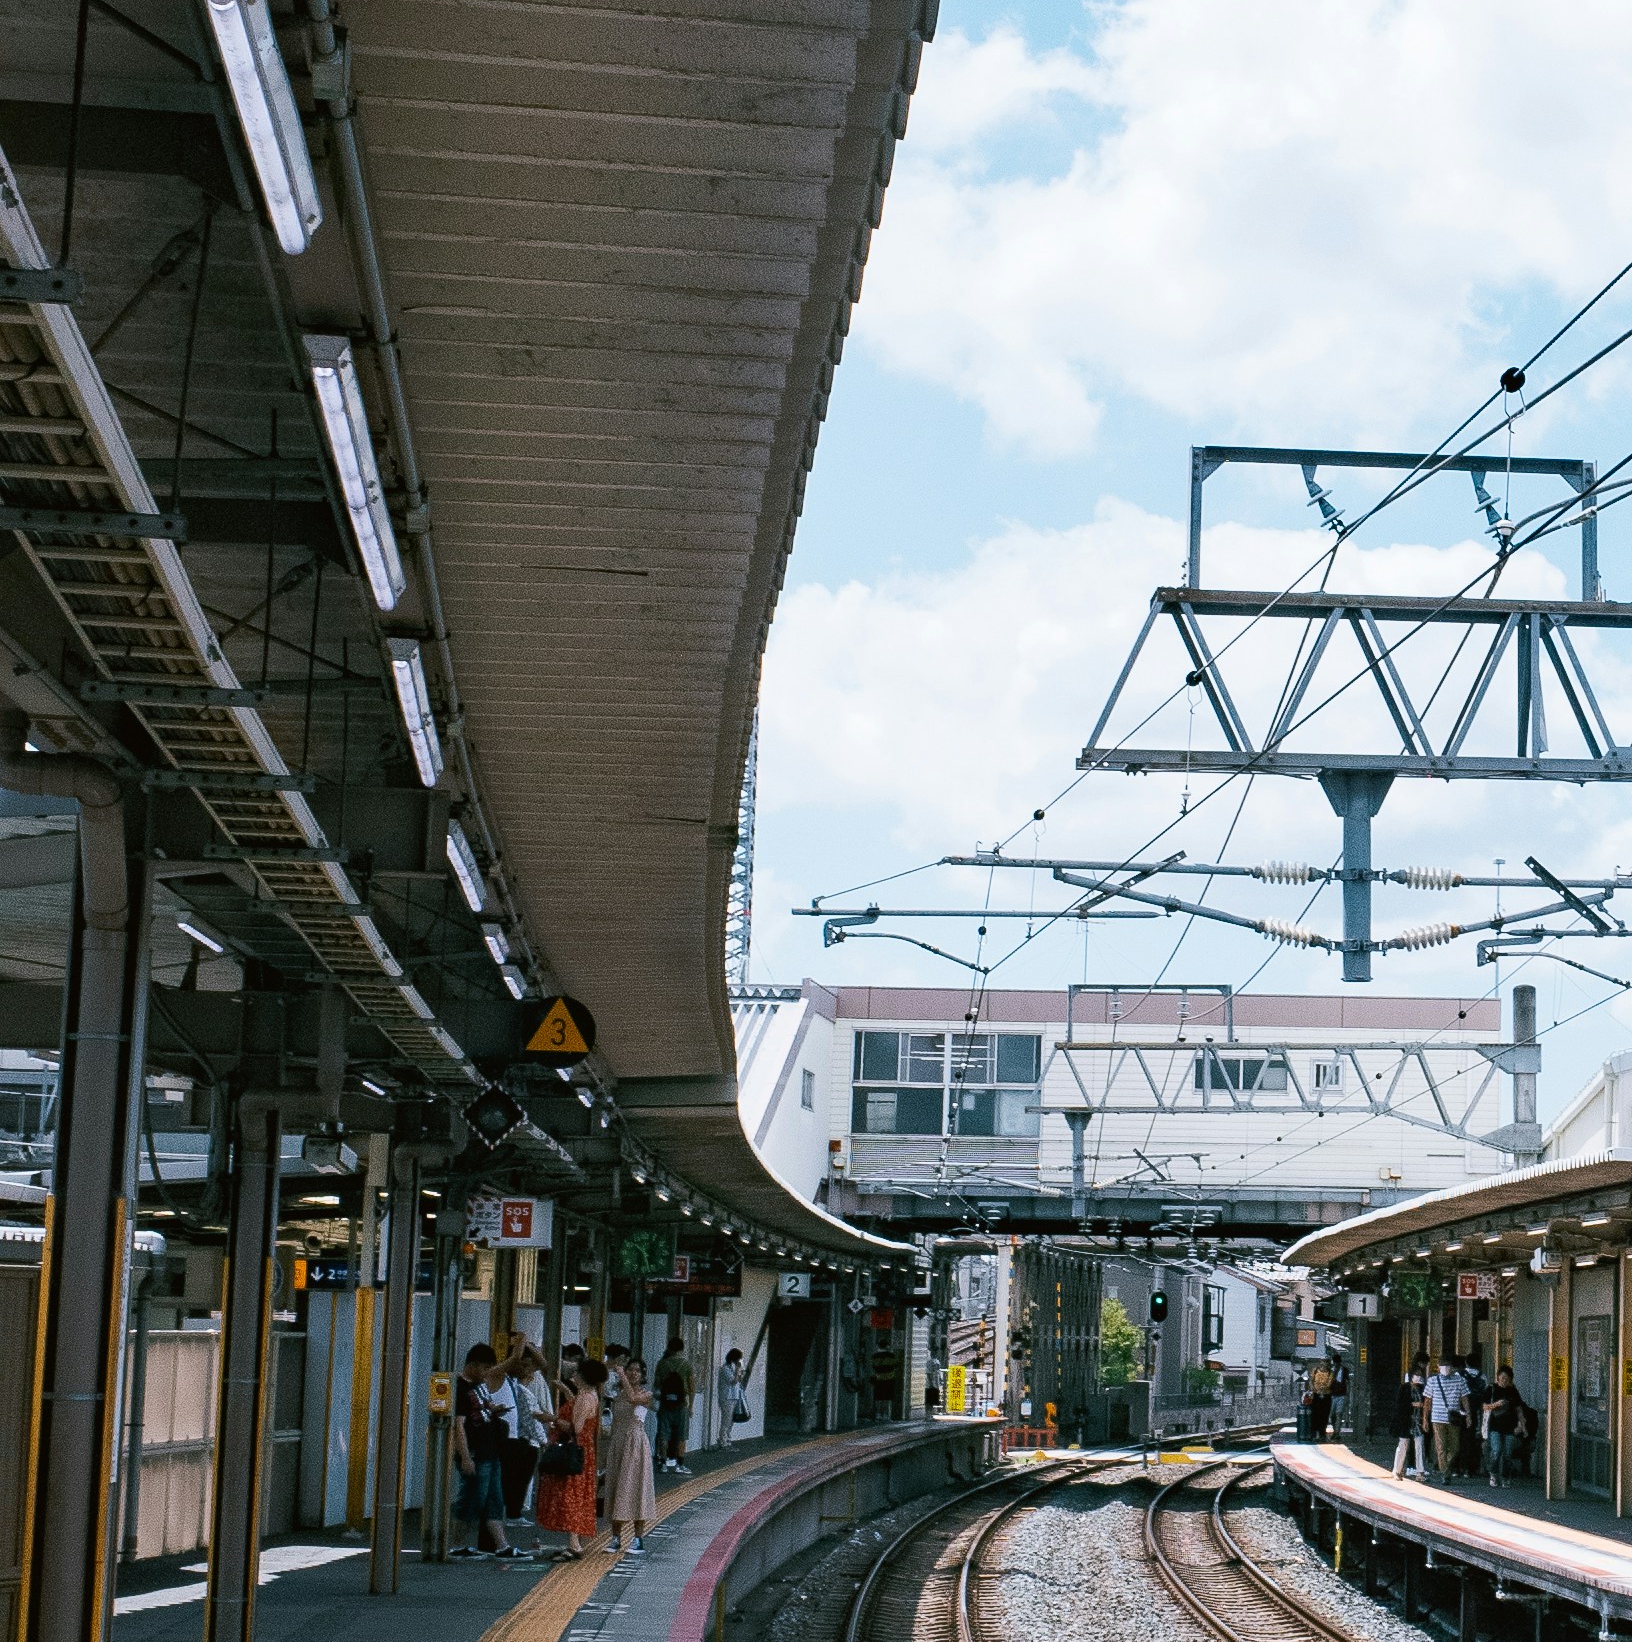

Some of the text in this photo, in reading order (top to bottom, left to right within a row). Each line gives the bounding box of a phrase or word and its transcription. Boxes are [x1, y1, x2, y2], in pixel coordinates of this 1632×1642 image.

[551, 1018, 567, 1046] 3
[505, 1207, 529, 1216] SOS
[787, 1276, 800, 1294] 2
[1359, 1297, 1367, 1314] 1
